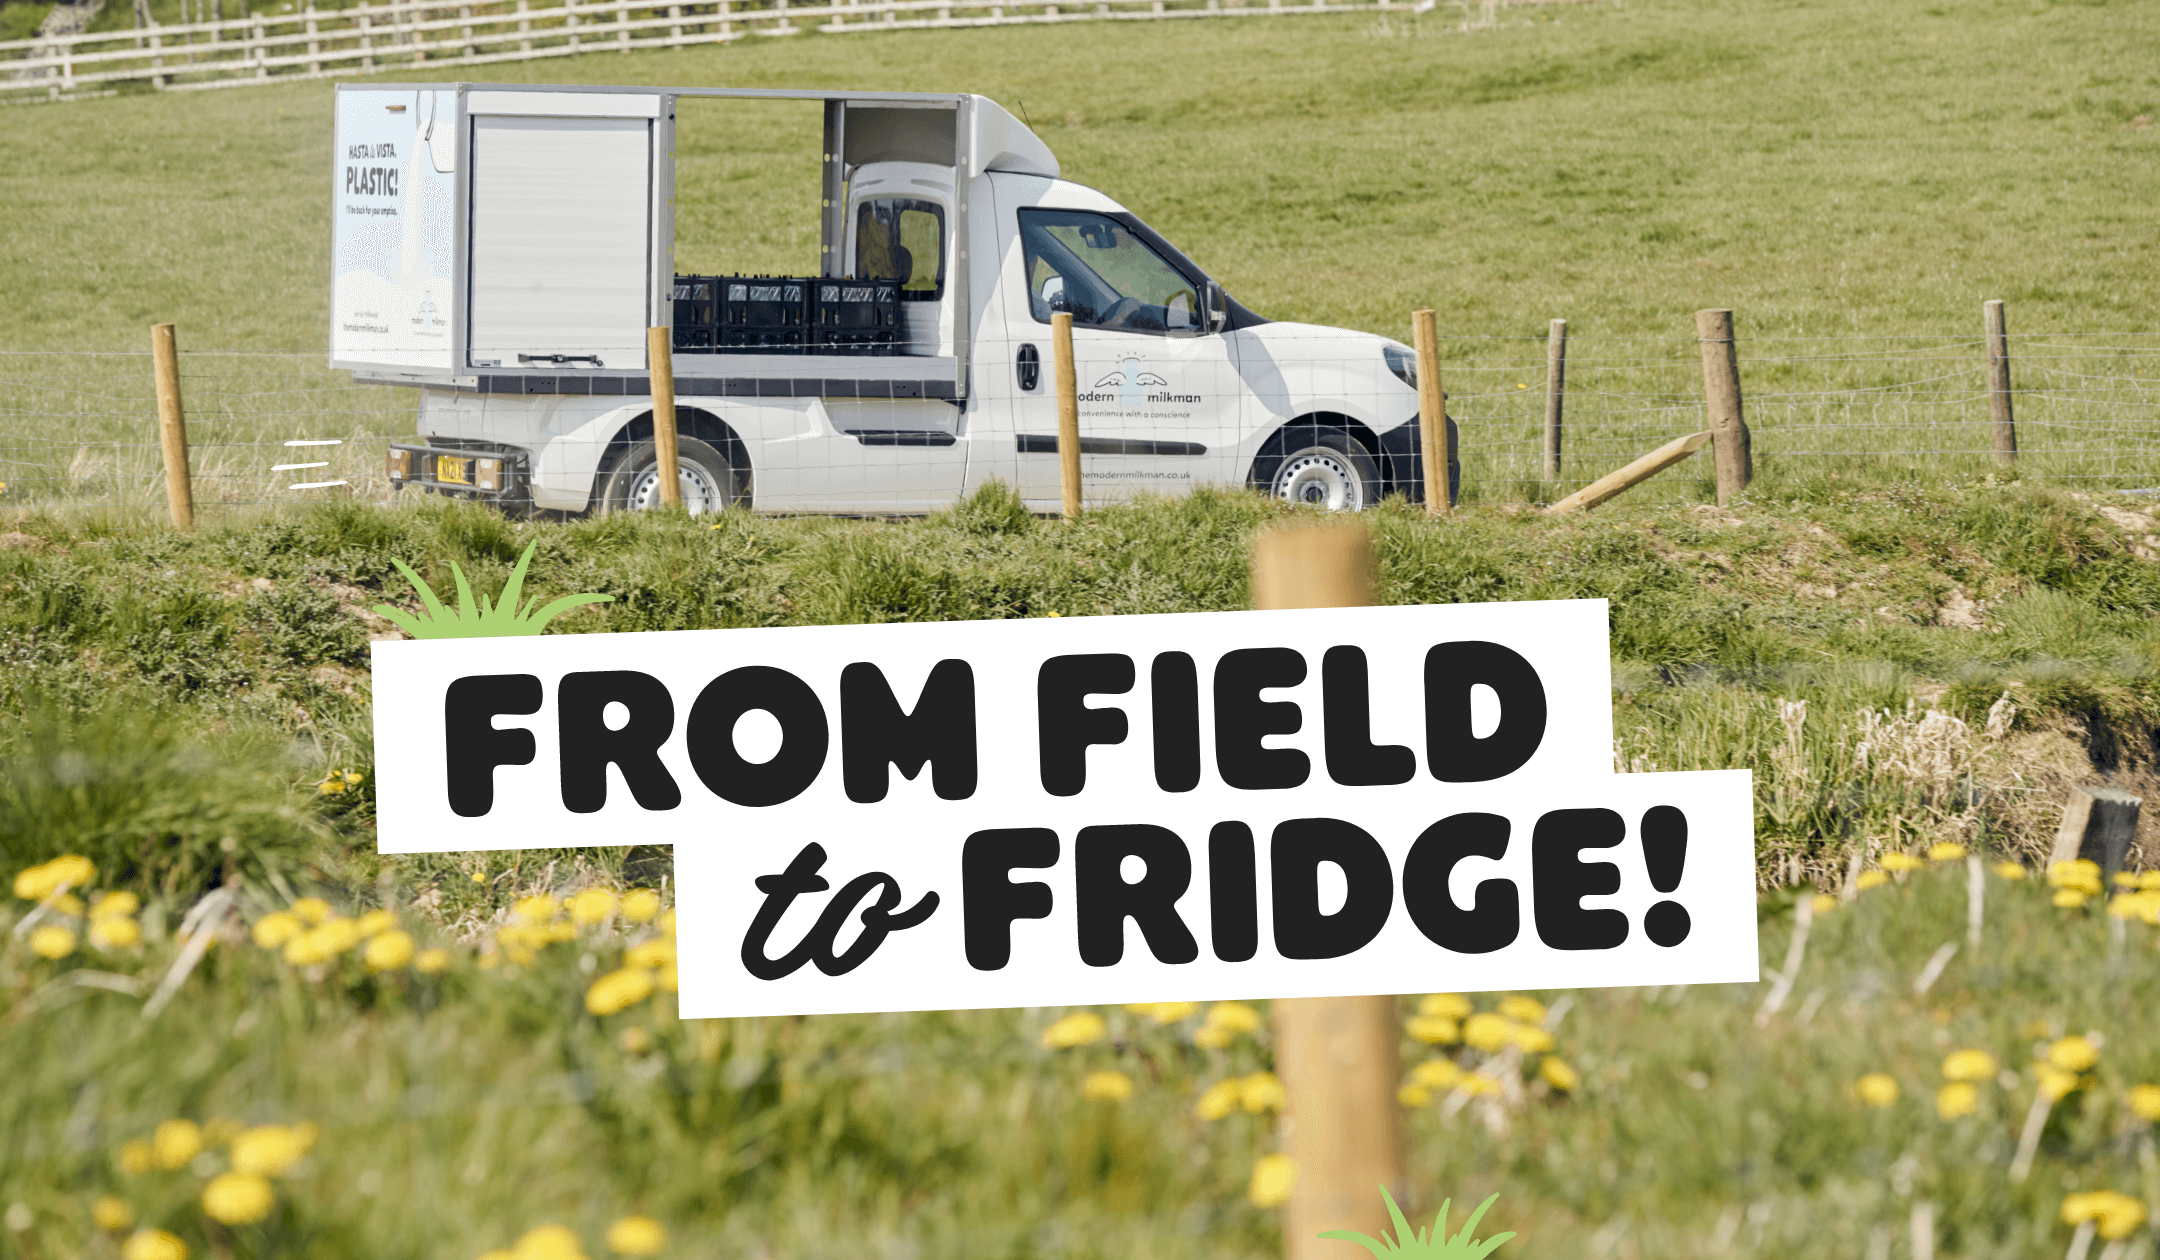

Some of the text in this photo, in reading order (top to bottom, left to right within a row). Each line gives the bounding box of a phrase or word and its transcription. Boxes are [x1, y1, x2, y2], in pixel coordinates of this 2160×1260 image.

[348, 144, 369, 160] HASTA
[376, 142, 397, 159] VISTA,
[346, 166, 398, 197] PLASTIC!
[356, 205, 365, 215] back
[1078, 391, 1201, 403] odern milkman
[1078, 410, 1124, 418] convenience
[1125, 410, 1142, 418] with
[1150, 411, 1191, 419] conscience
